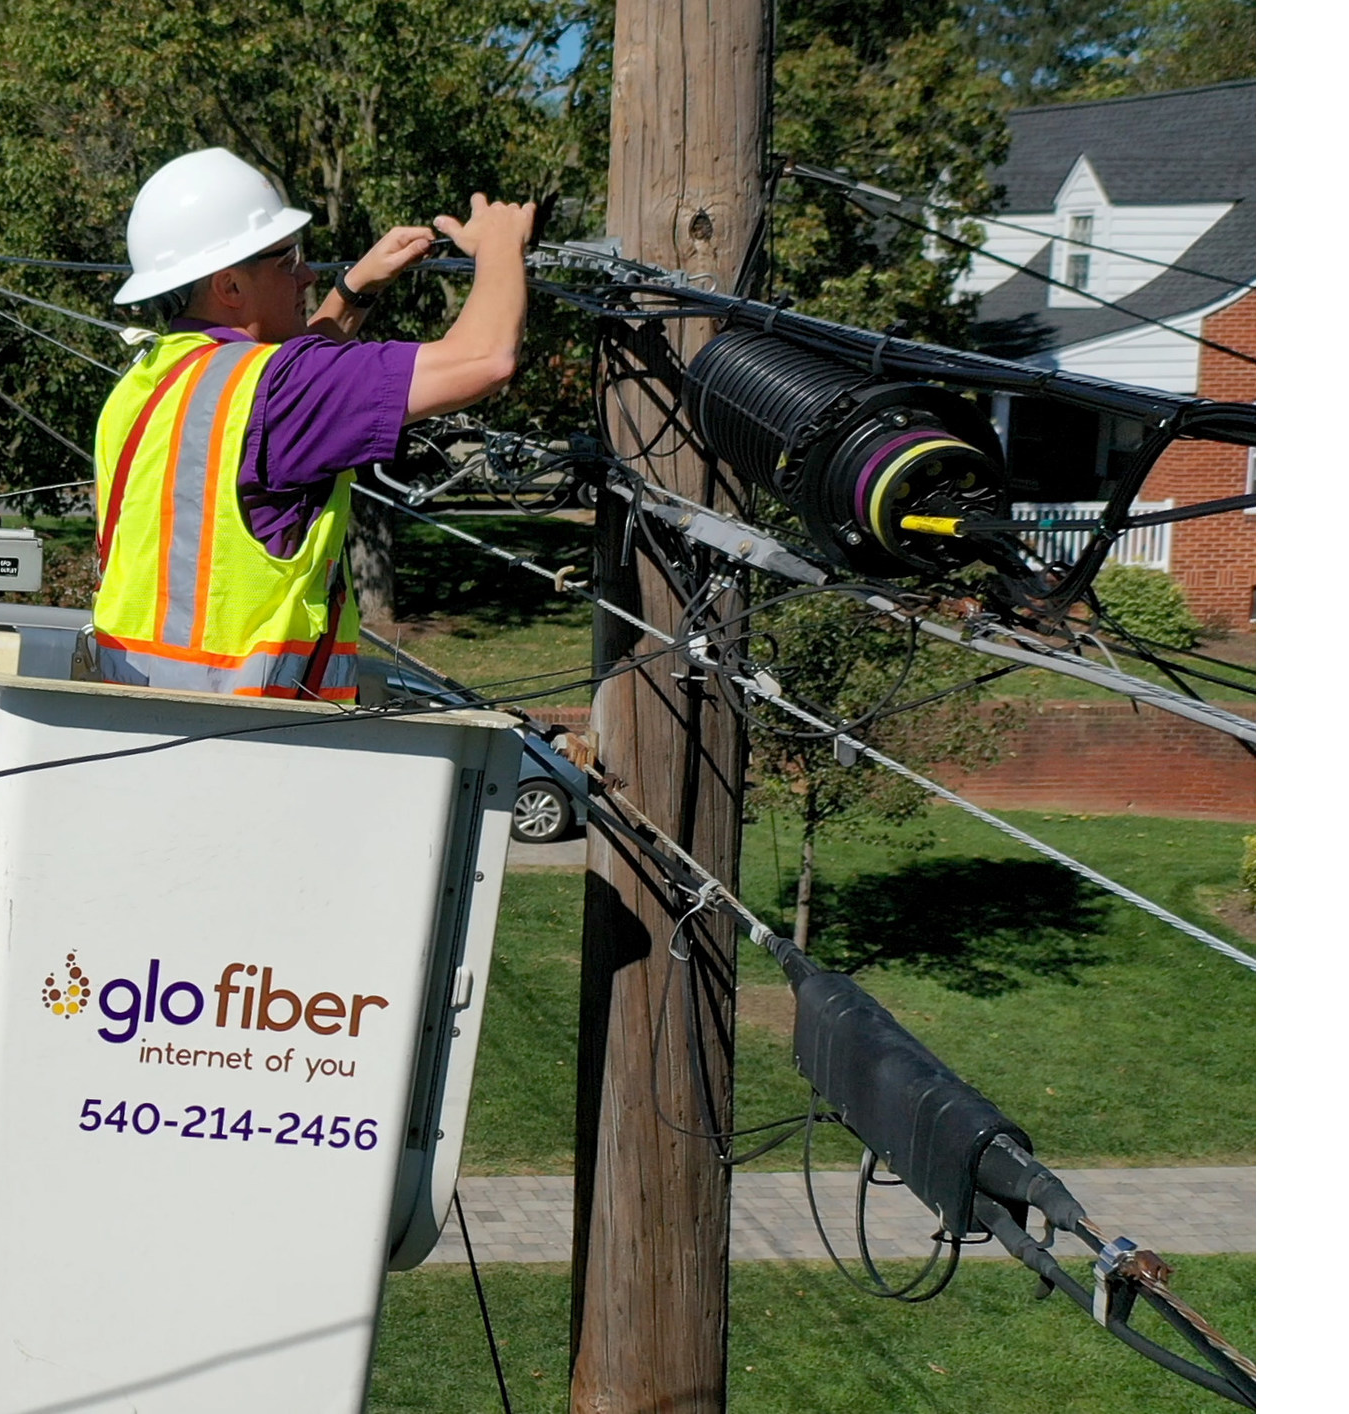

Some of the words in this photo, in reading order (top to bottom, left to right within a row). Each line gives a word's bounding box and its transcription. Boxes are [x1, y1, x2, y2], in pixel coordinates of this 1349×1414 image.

[97, 958, 205, 1044] glo
[214, 962, 390, 1038] fiber
[138, 1038, 254, 1071] internet
[265, 1047, 296, 1073] of
[305, 1056, 356, 1083] you
[78, 1098, 379, 1151] 540-214-2456
